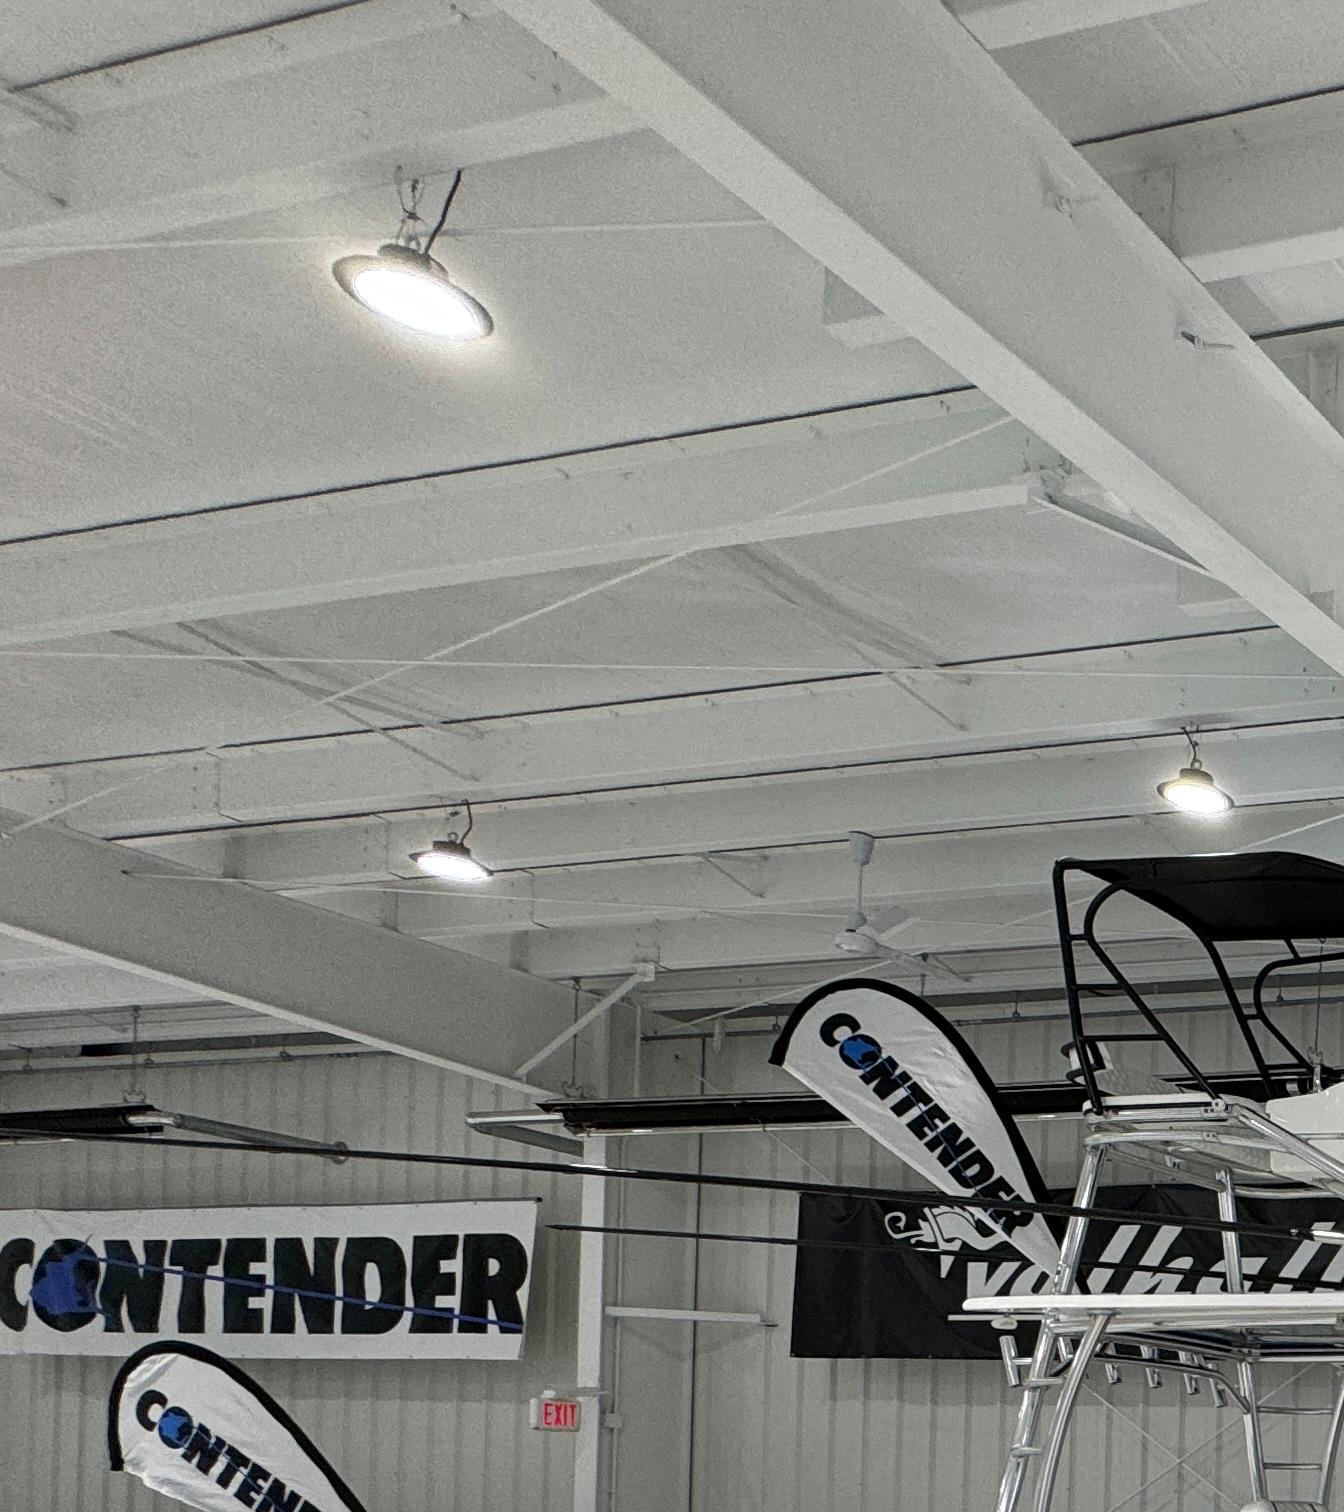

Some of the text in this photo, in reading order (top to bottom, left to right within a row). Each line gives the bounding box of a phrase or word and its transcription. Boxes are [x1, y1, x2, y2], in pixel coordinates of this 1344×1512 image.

[819, 1012, 1035, 1238] CONTENDER
[0, 1233, 528, 1335] CONTENDER
[543, 1402, 577, 1427] EXIT
